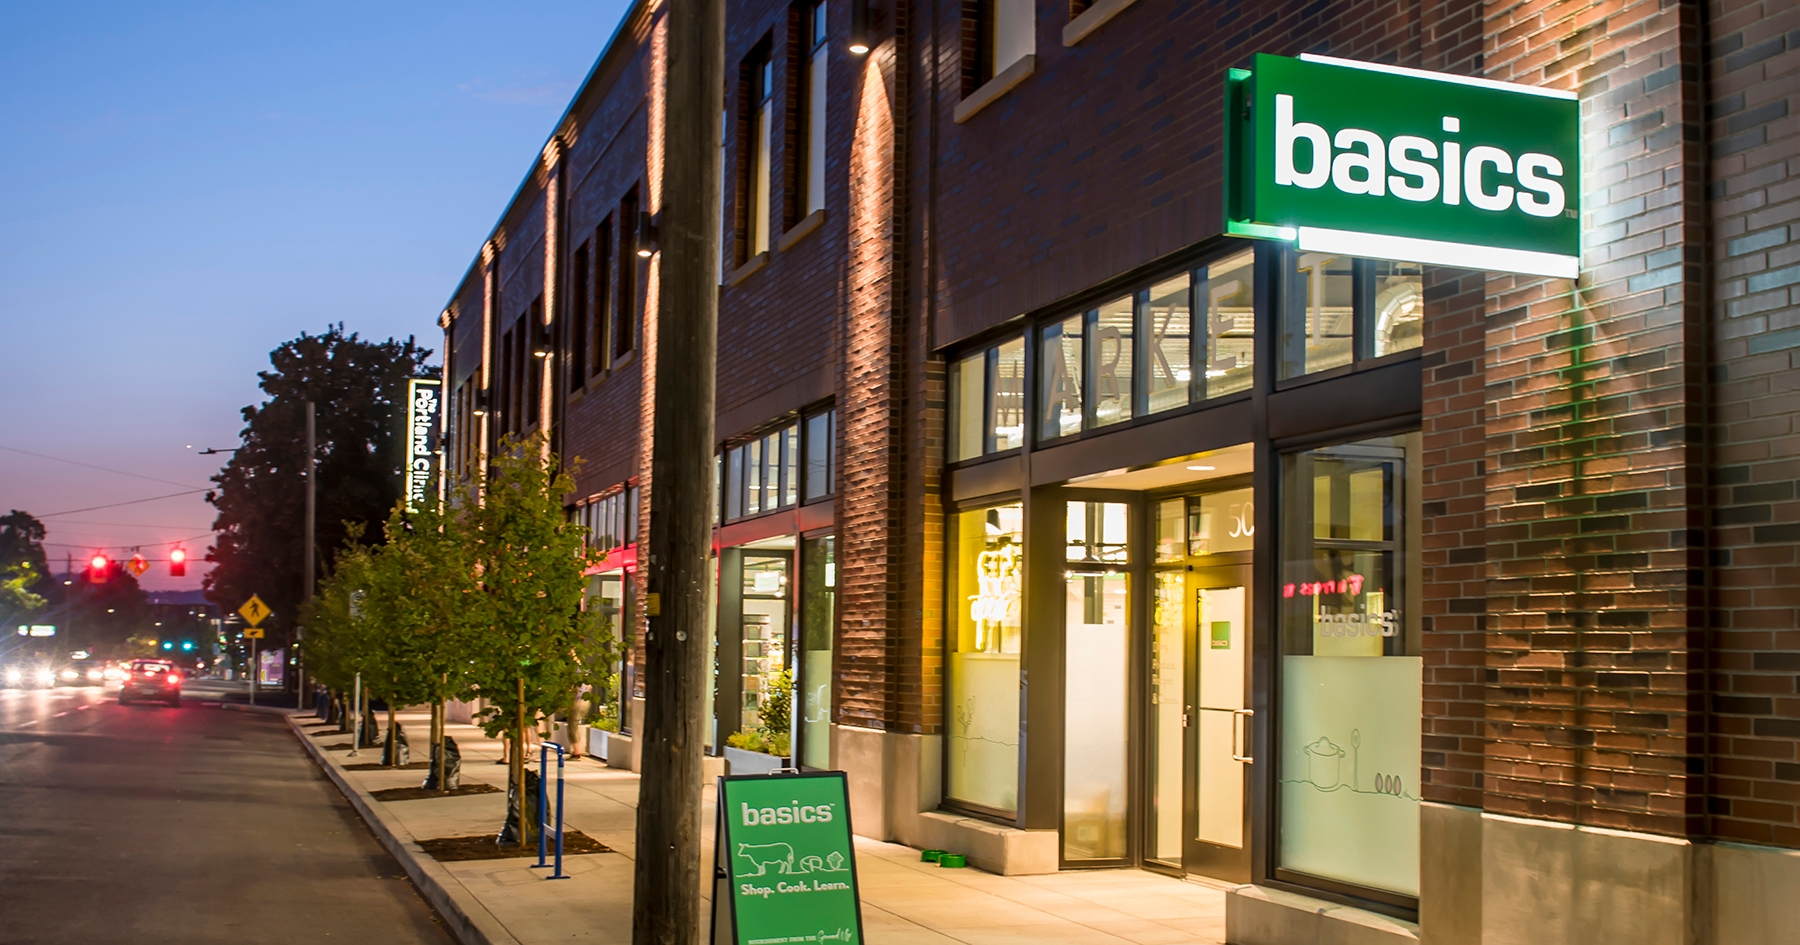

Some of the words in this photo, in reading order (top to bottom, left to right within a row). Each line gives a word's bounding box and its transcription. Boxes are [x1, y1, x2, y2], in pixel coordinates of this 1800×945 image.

[1275, 94, 1566, 218] basics
[989, 252, 1338, 437] MARKET
[414, 388, 433, 456] Portland
[1320, 604, 1395, 637] basics
[741, 800, 833, 826] basics
[740, 883, 775, 899] Shop.
[776, 880, 811, 893] Cook.
[813, 879, 850, 891] Learn.
